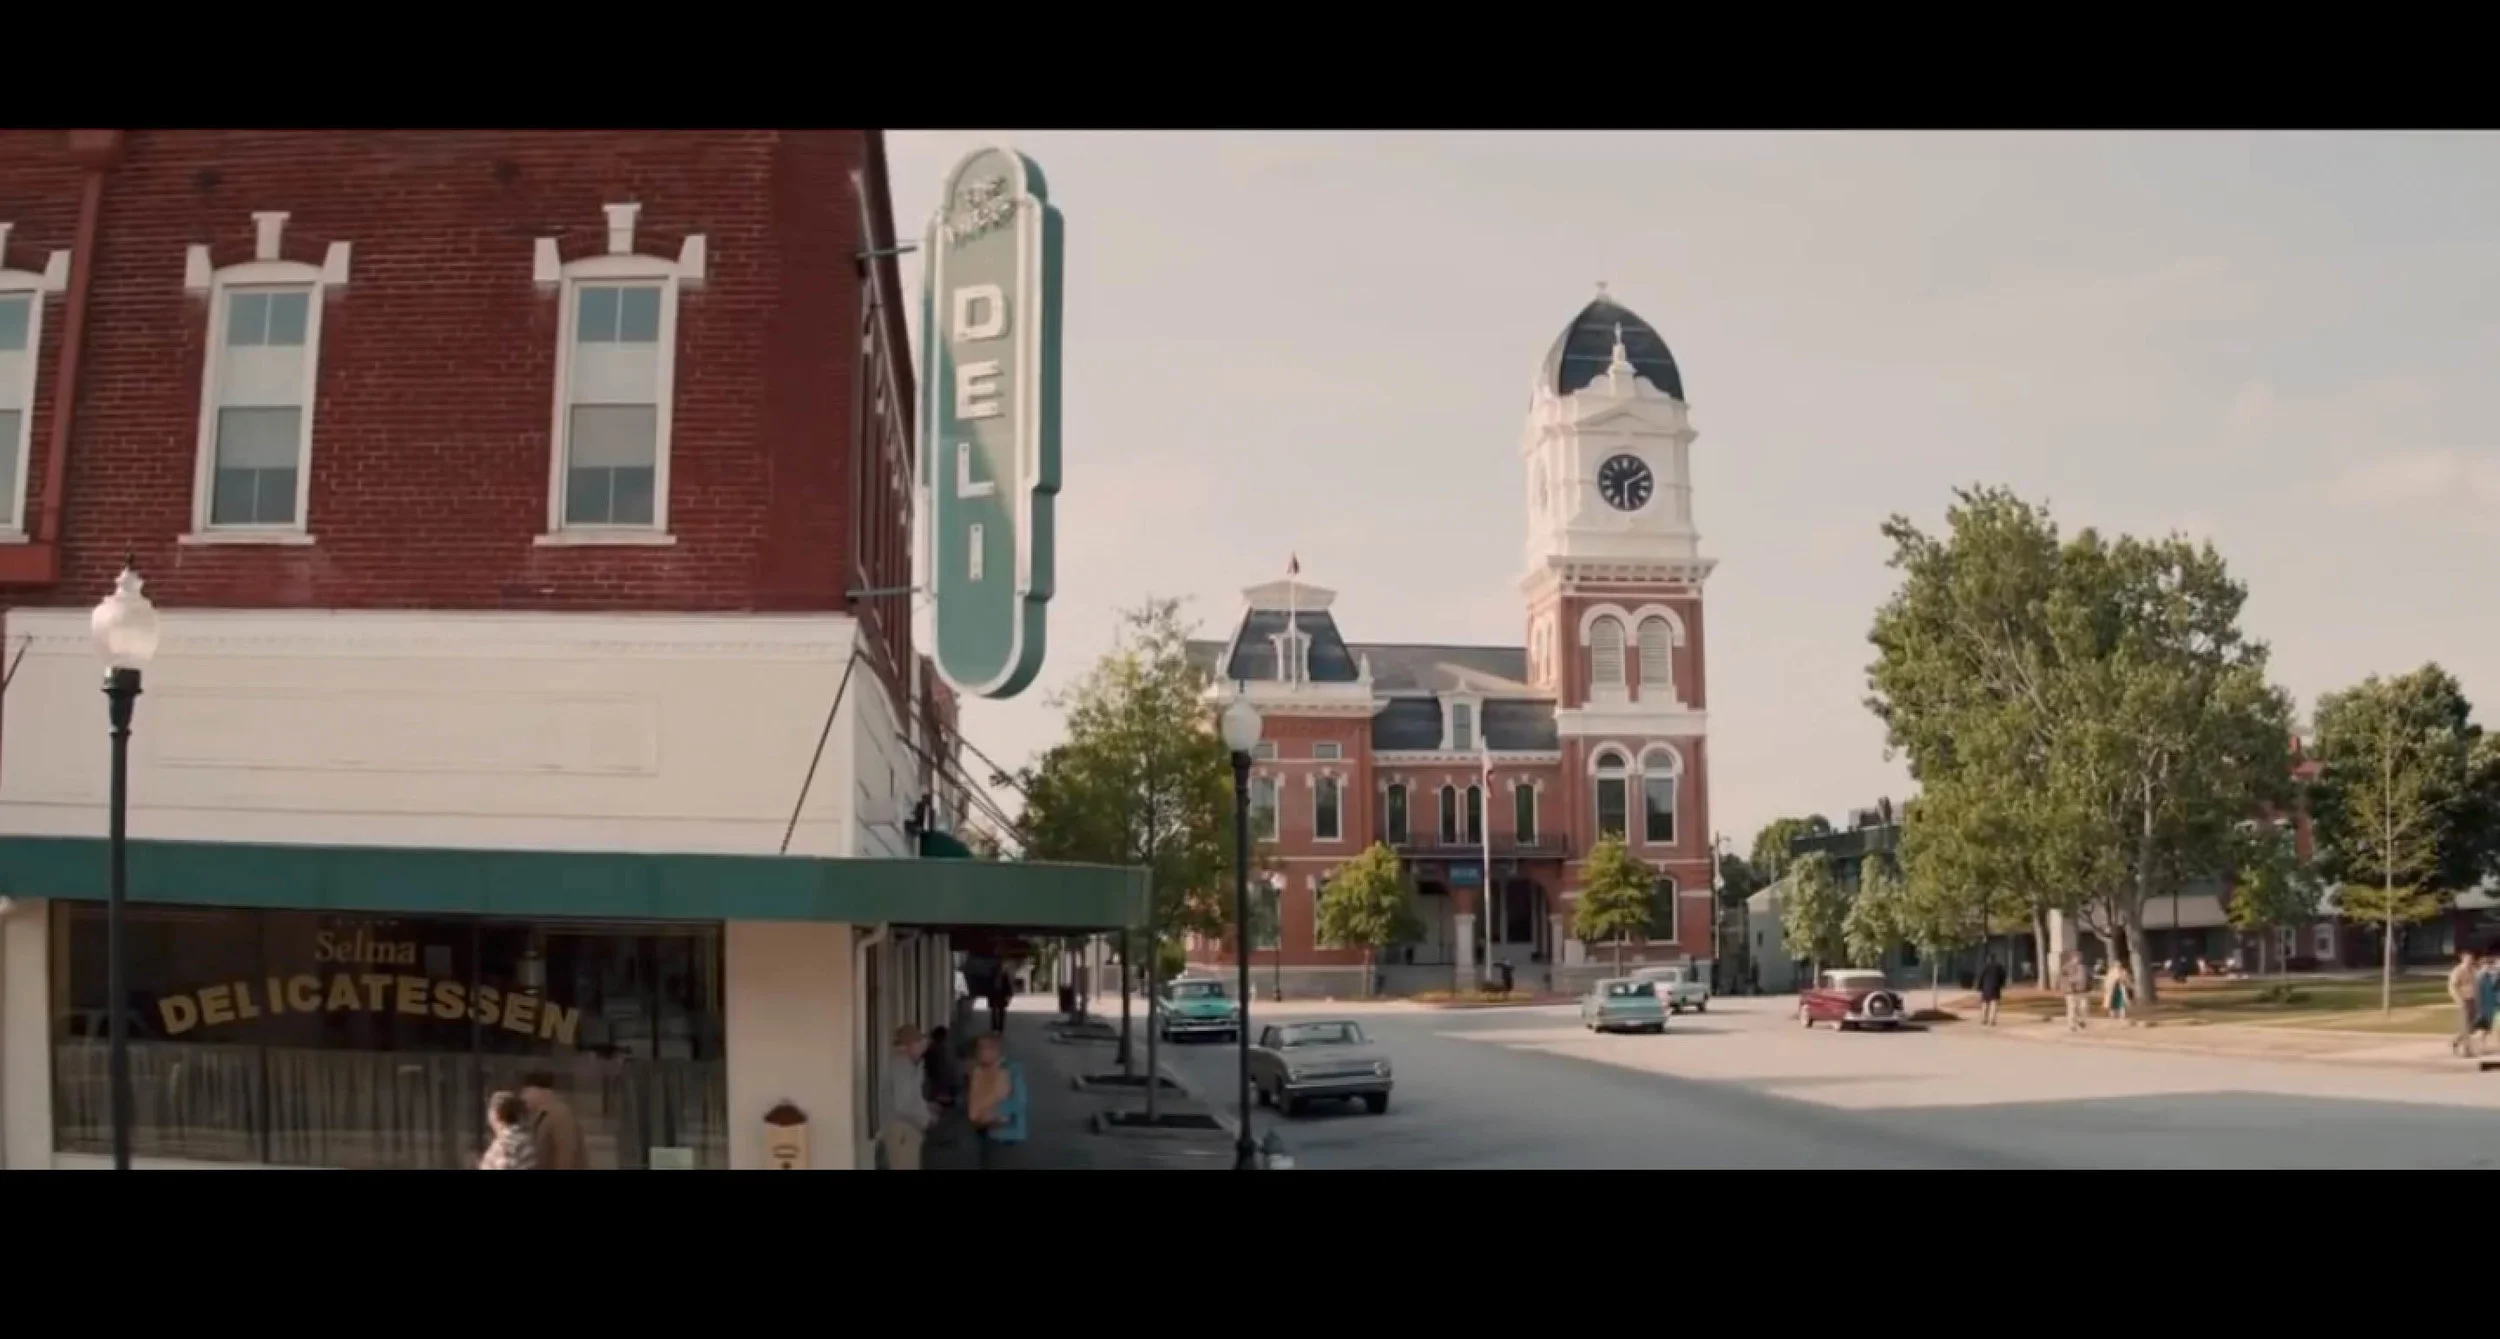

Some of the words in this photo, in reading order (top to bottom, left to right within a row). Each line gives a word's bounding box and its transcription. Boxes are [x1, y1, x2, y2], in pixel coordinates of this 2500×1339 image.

[954, 284, 1004, 581] DELI
[315, 929, 417, 965] Selma
[156, 973, 580, 1045] DELICATESSEN
